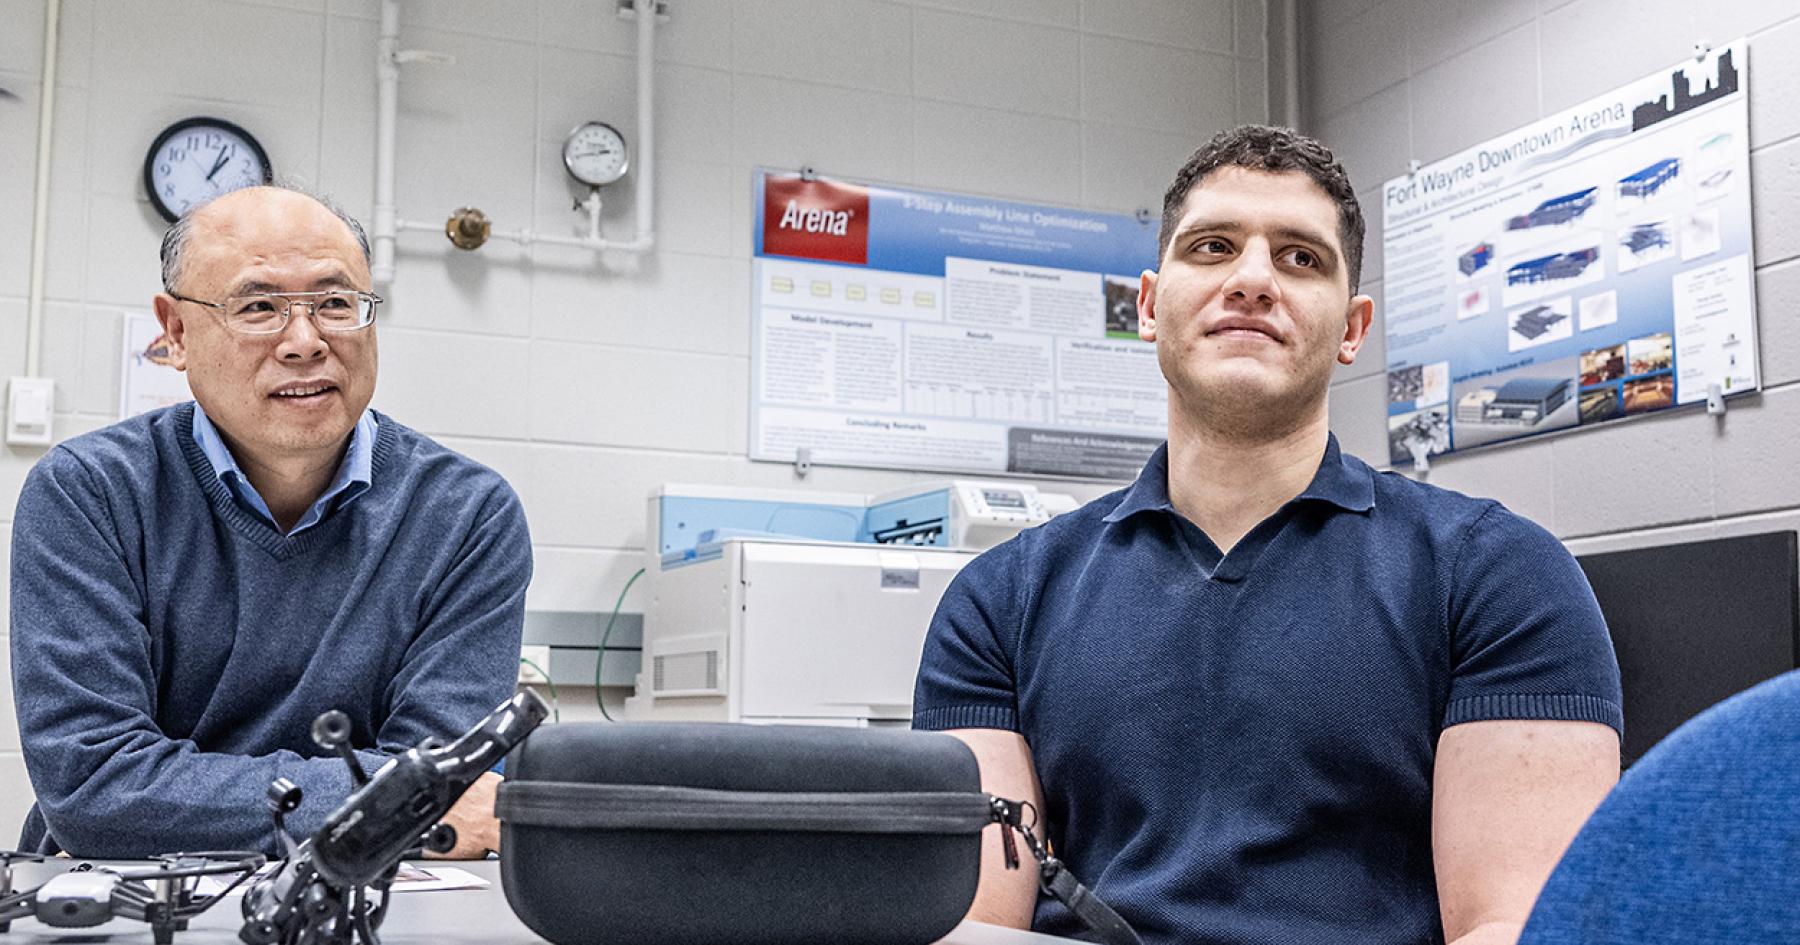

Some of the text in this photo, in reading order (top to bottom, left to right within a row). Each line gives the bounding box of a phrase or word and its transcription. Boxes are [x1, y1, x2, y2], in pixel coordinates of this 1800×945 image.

[187, 136, 199, 150] 11
[205, 133, 222, 149] 12
[169, 147, 186, 162] 10
[230, 143, 237, 157] 1
[1386, 183, 1418, 207] Fort
[1421, 161, 1474, 194] Wayne
[1478, 126, 1565, 173] Downtown
[1570, 102, 1625, 132] Arena
[160, 164, 171, 176] 9
[241, 160, 252, 174] 2
[165, 183, 175, 197] 8
[779, 198, 848, 236] Arena
[945, 200, 1004, 222] Assembly
[1006, 208, 1030, 222] Line
[1033, 212, 1109, 233] Optimization
[791, 313, 873, 330] Model Development
[846, 417, 927, 431] Concluding Remarks
